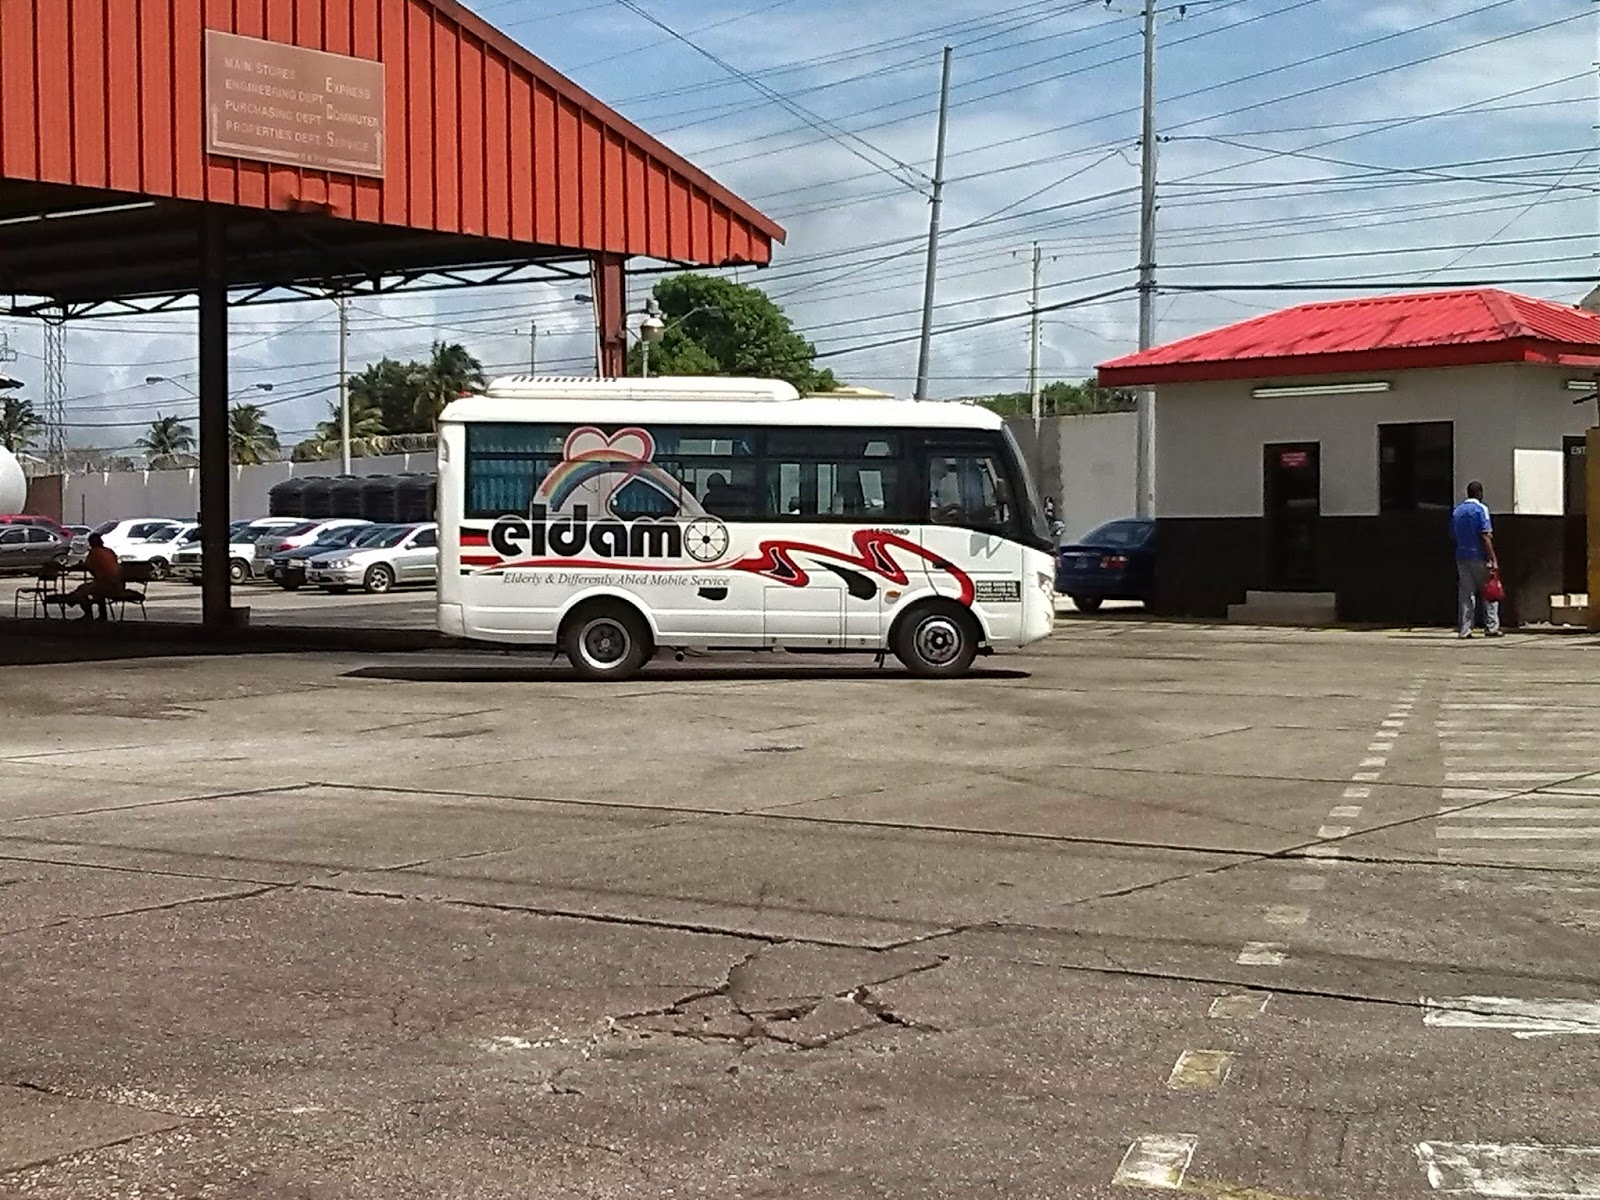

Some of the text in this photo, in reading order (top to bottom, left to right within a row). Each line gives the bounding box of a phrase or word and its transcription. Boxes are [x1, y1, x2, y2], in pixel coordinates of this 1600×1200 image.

[224, 57, 252, 72] MAIN
[503, 572, 730, 587] Elderly & Differently Abled Mobile Service
